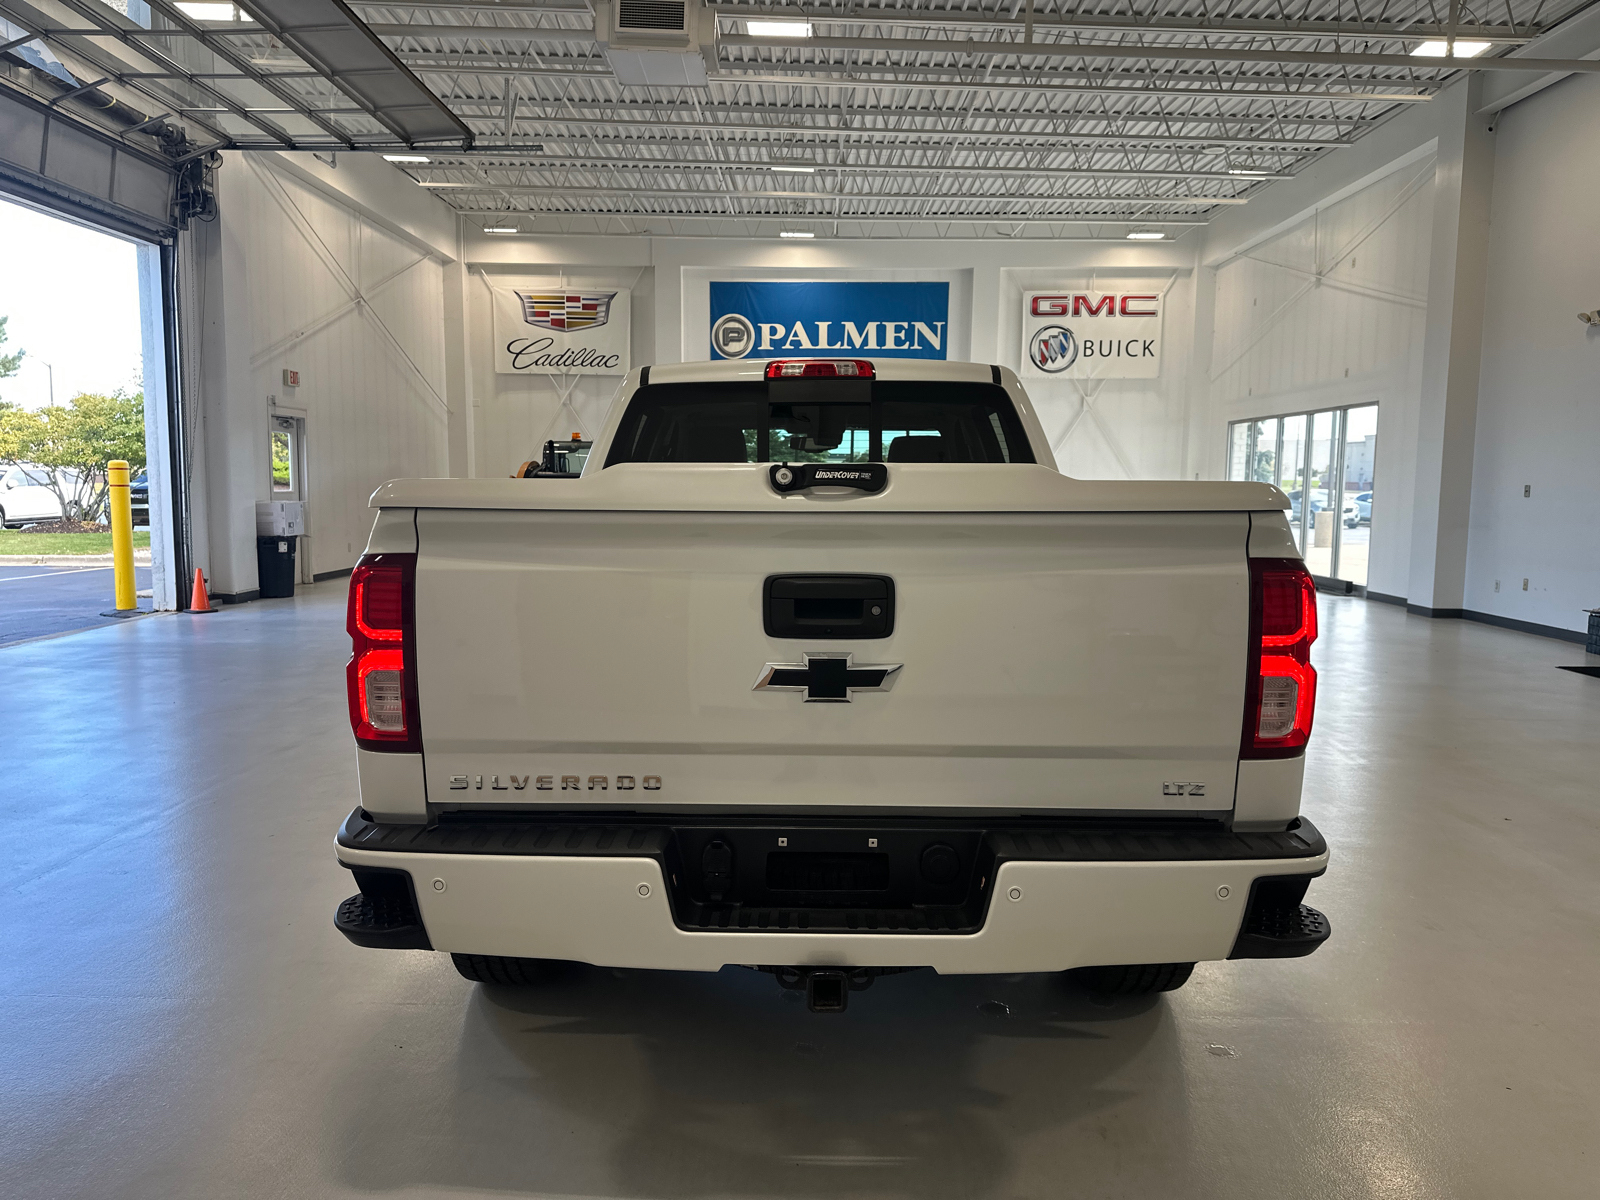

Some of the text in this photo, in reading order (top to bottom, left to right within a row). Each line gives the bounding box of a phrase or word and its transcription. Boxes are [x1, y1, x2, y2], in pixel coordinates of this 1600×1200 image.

[1030, 294, 1159, 318] GMC
[757, 322, 946, 351] PALMEN
[507, 337, 620, 370] Cadillac
[1083, 340, 1155, 357] BUICK
[449, 775, 663, 790] SILVERADO
[1163, 782, 1205, 796] LTZ
